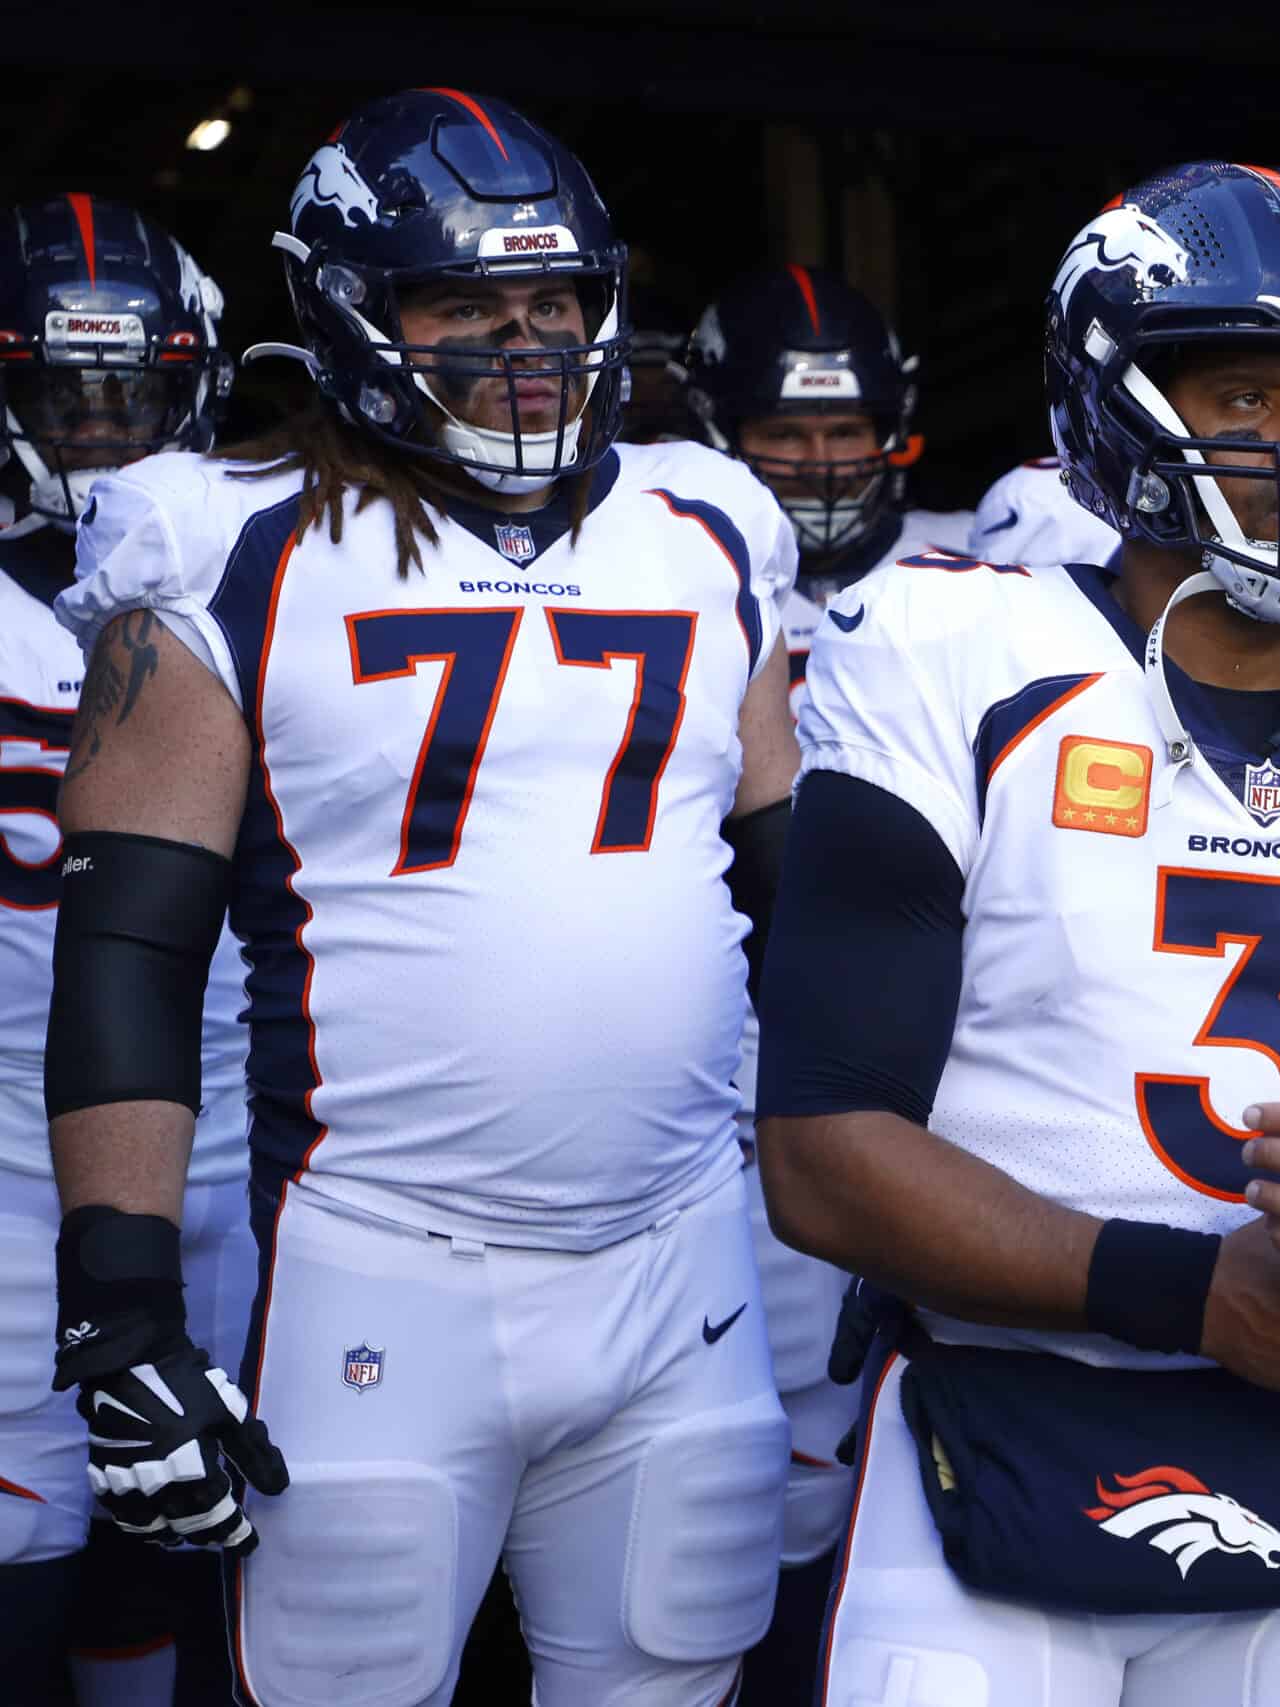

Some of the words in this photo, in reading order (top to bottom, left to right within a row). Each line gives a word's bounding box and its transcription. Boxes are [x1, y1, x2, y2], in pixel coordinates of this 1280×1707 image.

[503, 233, 559, 252] BRONCOS
[67, 319, 121, 334] BRONCOS
[459, 580, 582, 596] BRONCOS
[344, 606, 698, 877] 77
[1063, 743, 1145, 810] C
[348, 1363, 376, 1384] NFL
